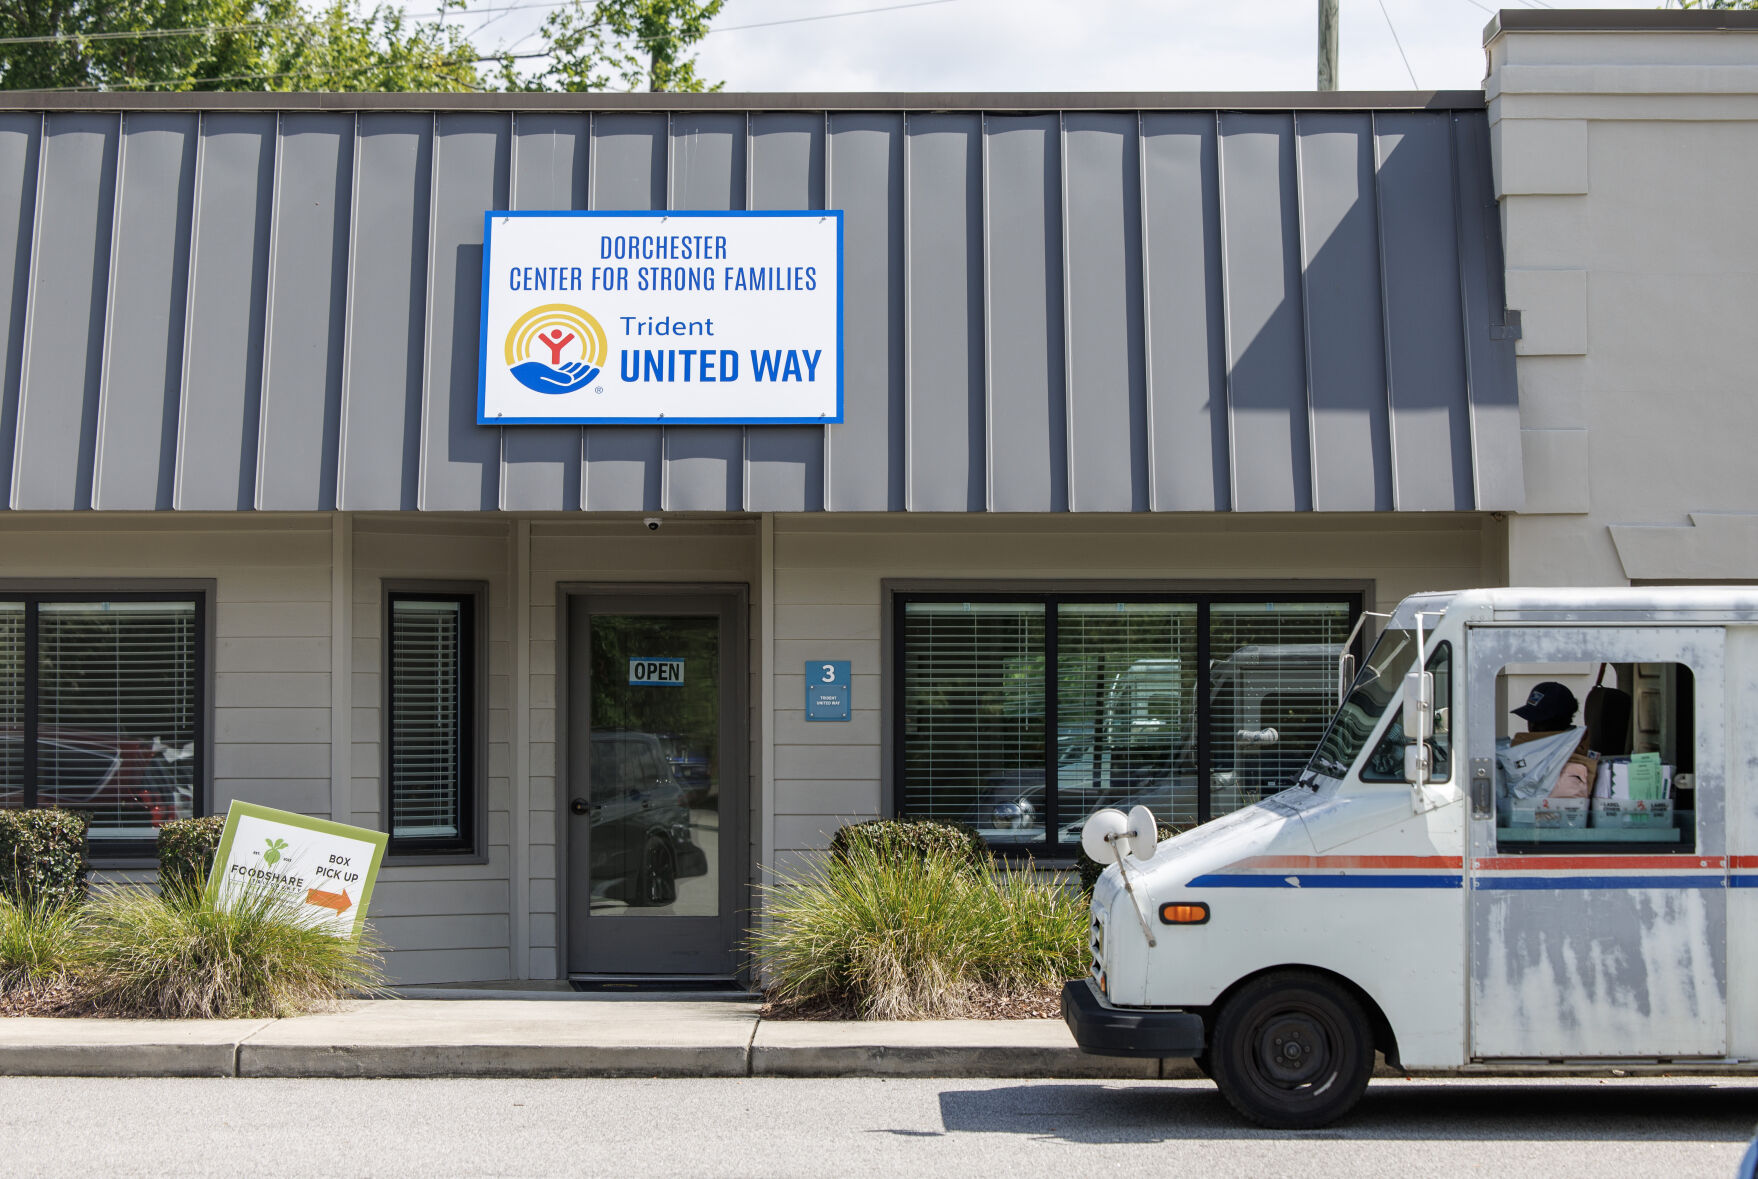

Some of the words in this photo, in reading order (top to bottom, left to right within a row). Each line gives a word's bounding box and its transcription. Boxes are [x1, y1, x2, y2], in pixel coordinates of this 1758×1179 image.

[600, 235, 727, 260] DORCHESTER
[510, 266, 582, 291] CENTER
[592, 266, 629, 291] FOR
[638, 266, 715, 291] STRONG
[725, 266, 817, 292] FAMILIES
[620, 315, 715, 337] Trident
[620, 349, 739, 383] UNITED
[750, 349, 822, 383] WAY
[634, 662, 680, 680] OPEN
[821, 664, 836, 683] 3
[329, 854, 351, 866] BOX
[231, 864, 304, 888] FOODSHARE
[315, 866, 342, 880] PICK
[344, 872, 359, 882] UP
